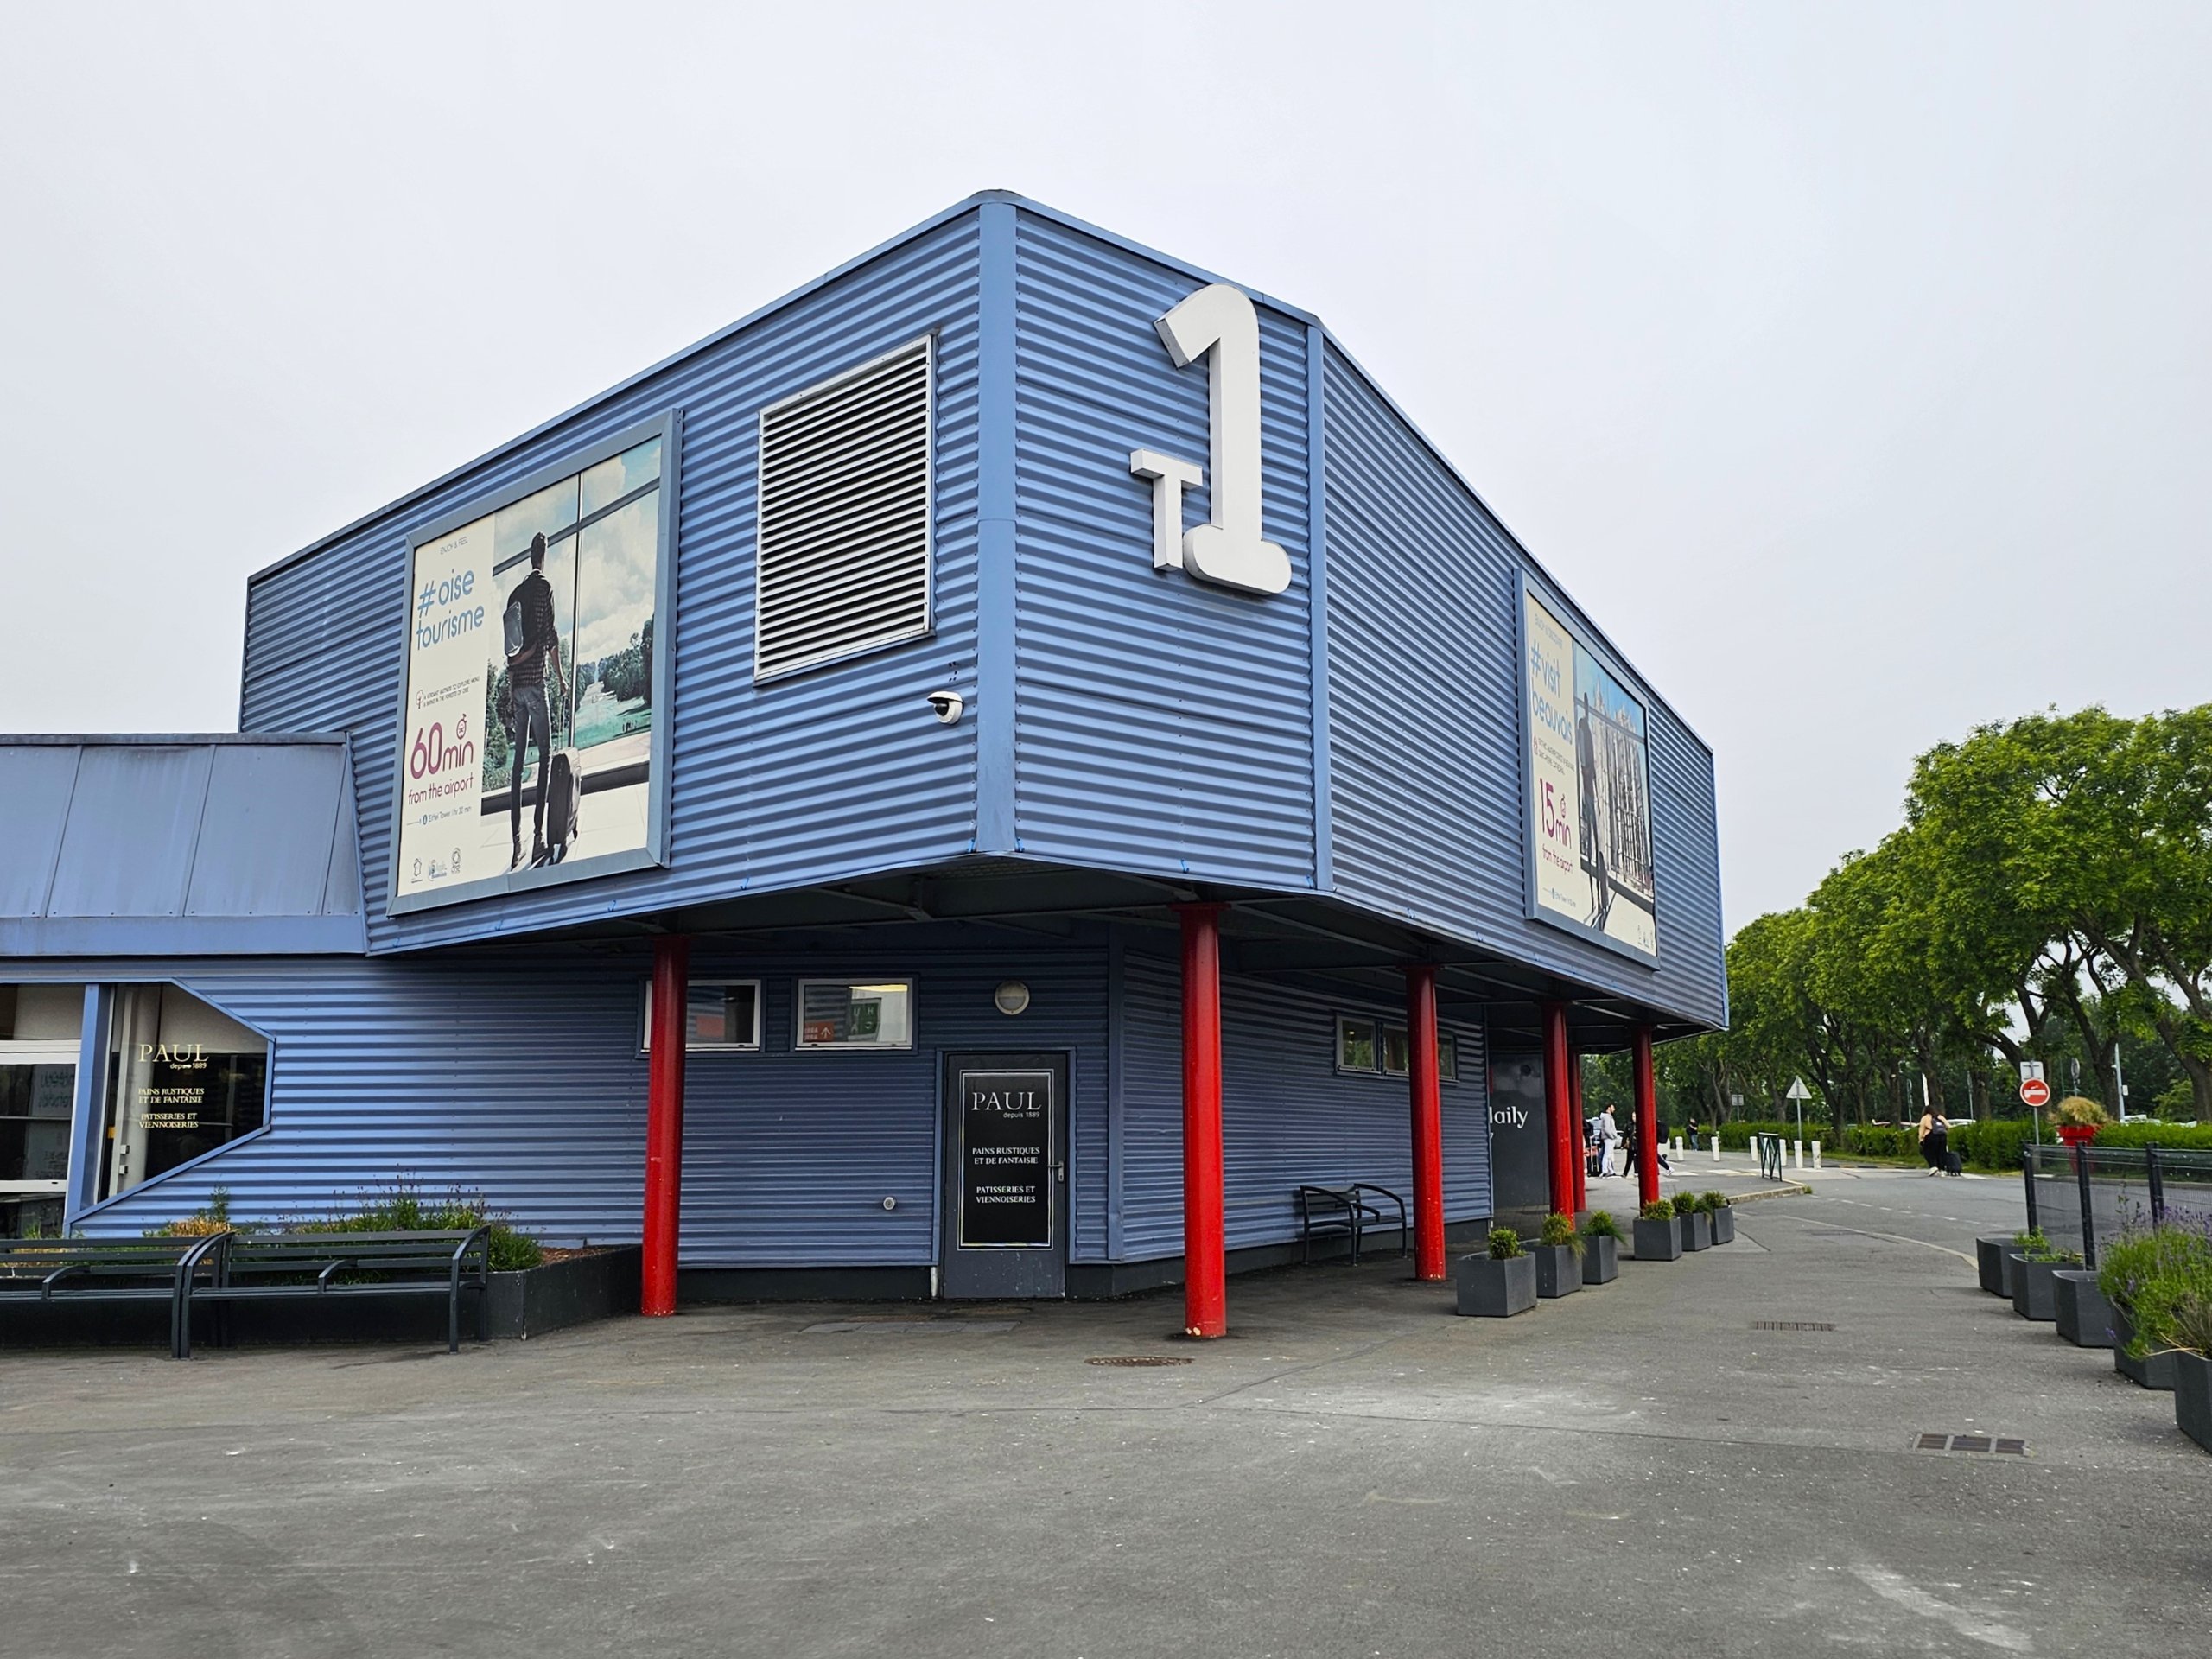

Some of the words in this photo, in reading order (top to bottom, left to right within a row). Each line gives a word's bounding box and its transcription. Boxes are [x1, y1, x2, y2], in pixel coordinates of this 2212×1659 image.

[416, 606, 484, 650] tourisme
[1532, 677, 1573, 745] beauvais
[408, 789, 427, 805] from
[429, 782, 442, 799] the
[444, 772, 474, 798] airport
[138, 1044, 209, 1063] PAUL
[162, 1088, 205, 1096] RUSTIQUES
[971, 1091, 1042, 1111] PAUL
[141, 1112, 185, 1121] PATISSERIES
[996, 1147, 1040, 1155] RUSTIQUES
[998, 1156, 1039, 1165] FANTAISIE
[976, 1185, 1024, 1194] PATISSERIES
